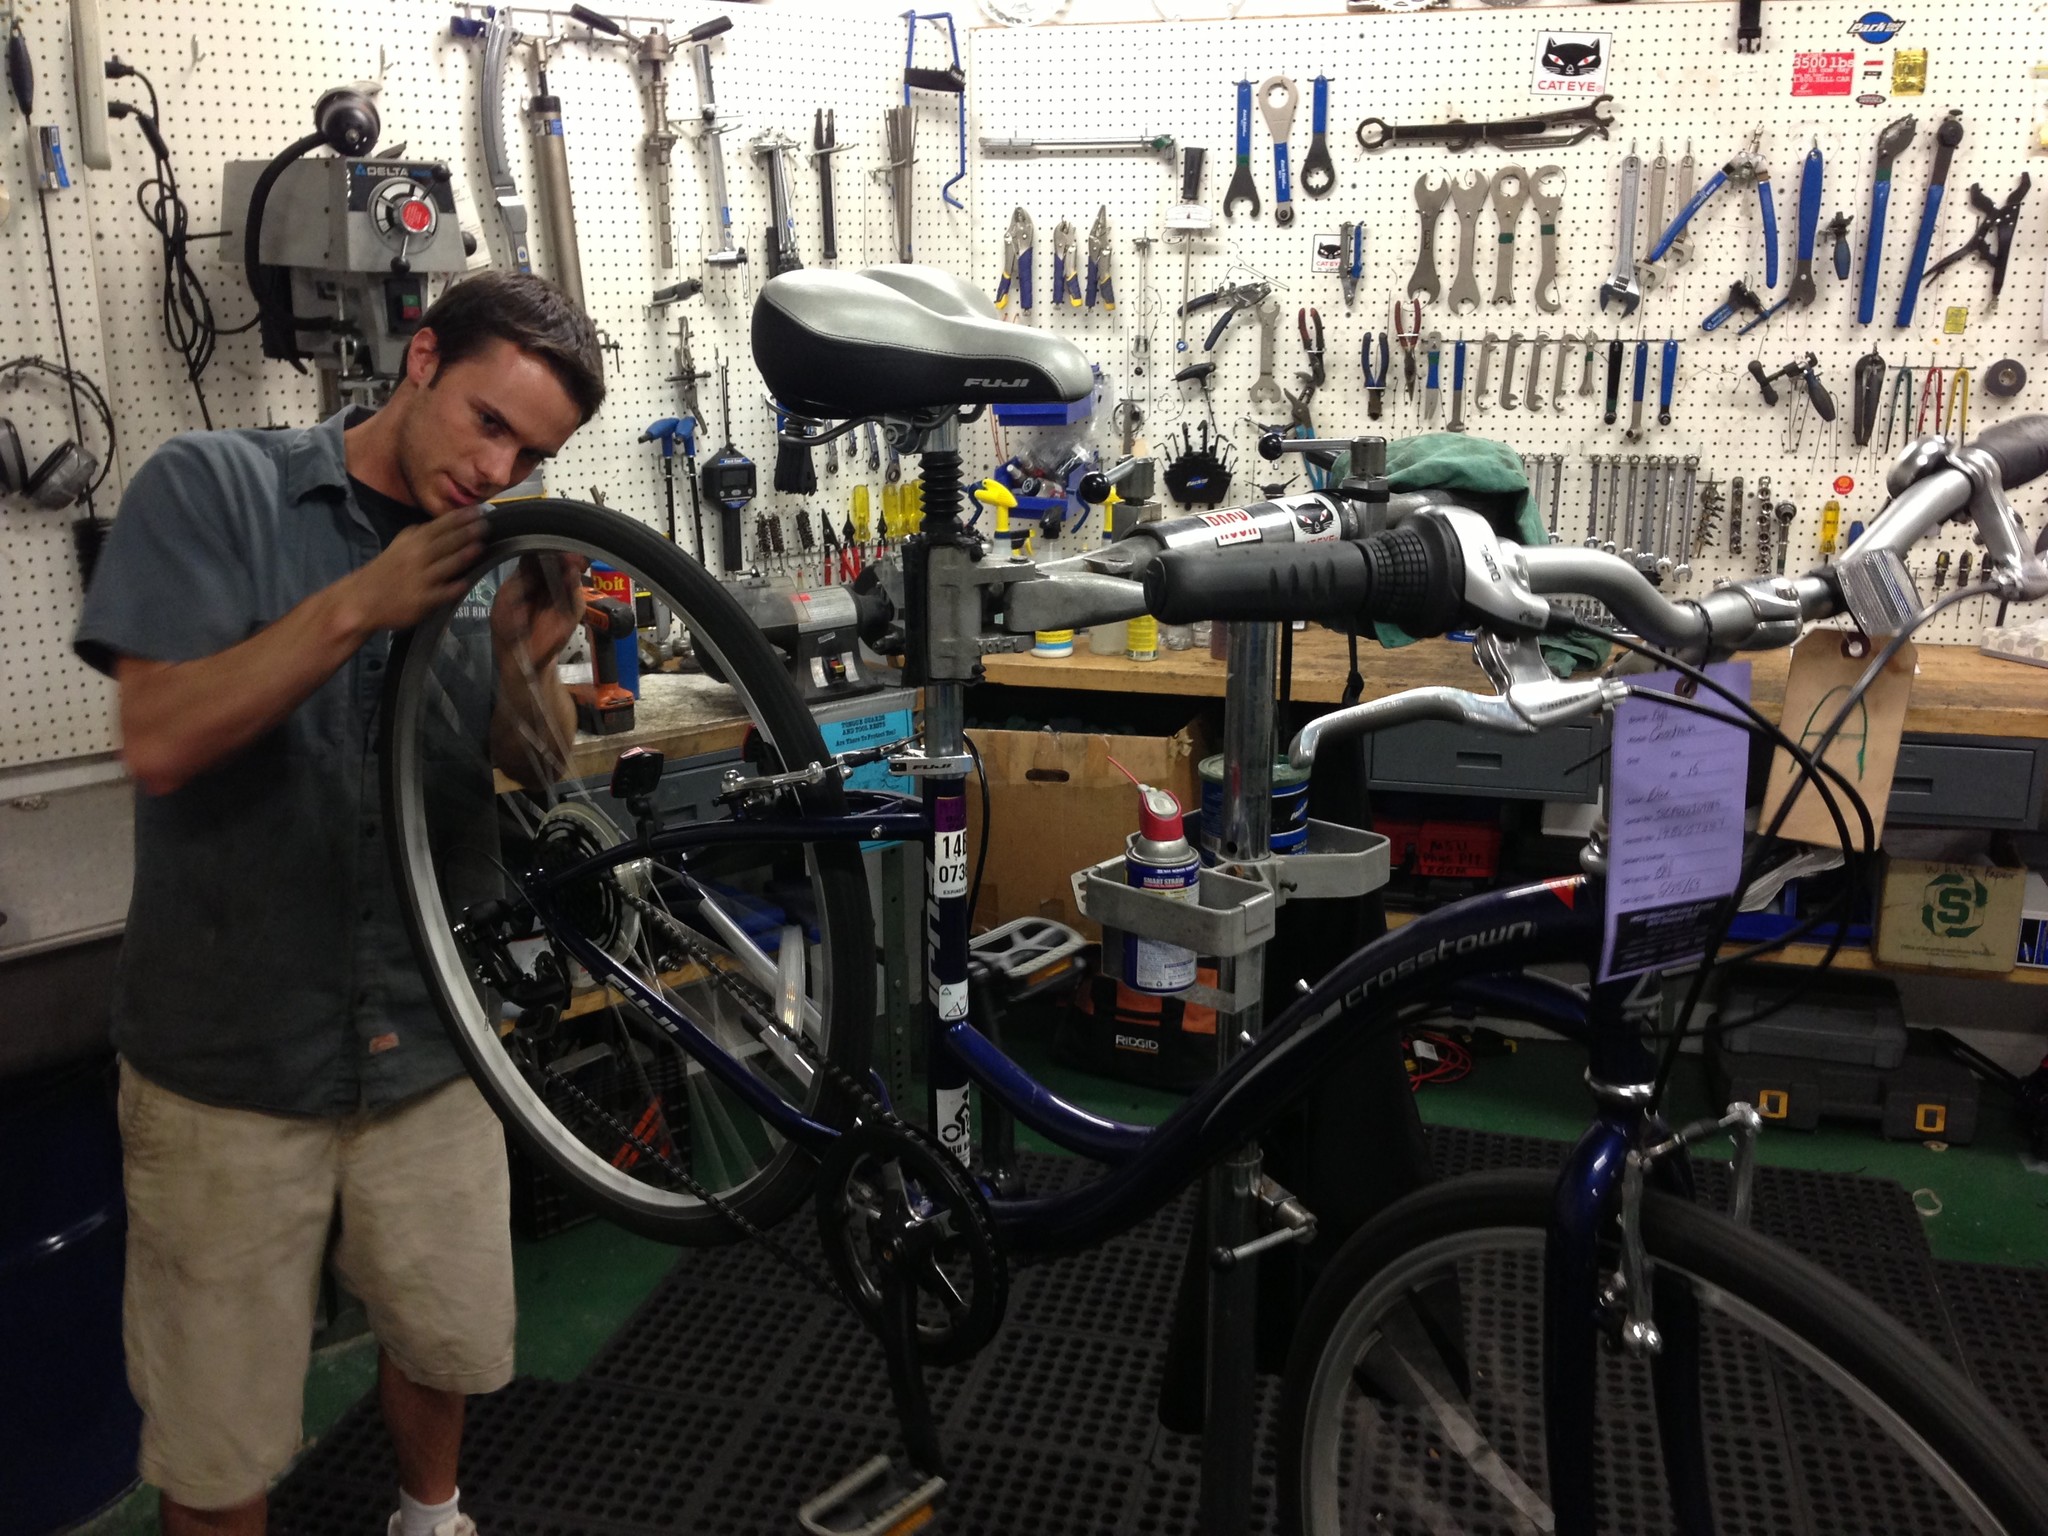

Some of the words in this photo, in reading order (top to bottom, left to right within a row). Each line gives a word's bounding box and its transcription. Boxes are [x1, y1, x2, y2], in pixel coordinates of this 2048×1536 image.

[1850, 21, 1887, 33] Park
[1794, 57, 1828, 69] 3500
[1830, 56, 1855, 68] lbs
[1537, 80, 1597, 92] CATEYE
[366, 166, 409, 177] DELTA
[963, 377, 1030, 388] FUJI
[454, 606, 470, 617] SU
[1789, 685, 1867, 782] A
[939, 863, 967, 884] 073
[1936, 887, 1972, 925] S
[1345, 920, 1533, 1008] crosstown
[605, 972, 680, 1034] FUJI
[1115, 1034, 1159, 1050] RIDGID
